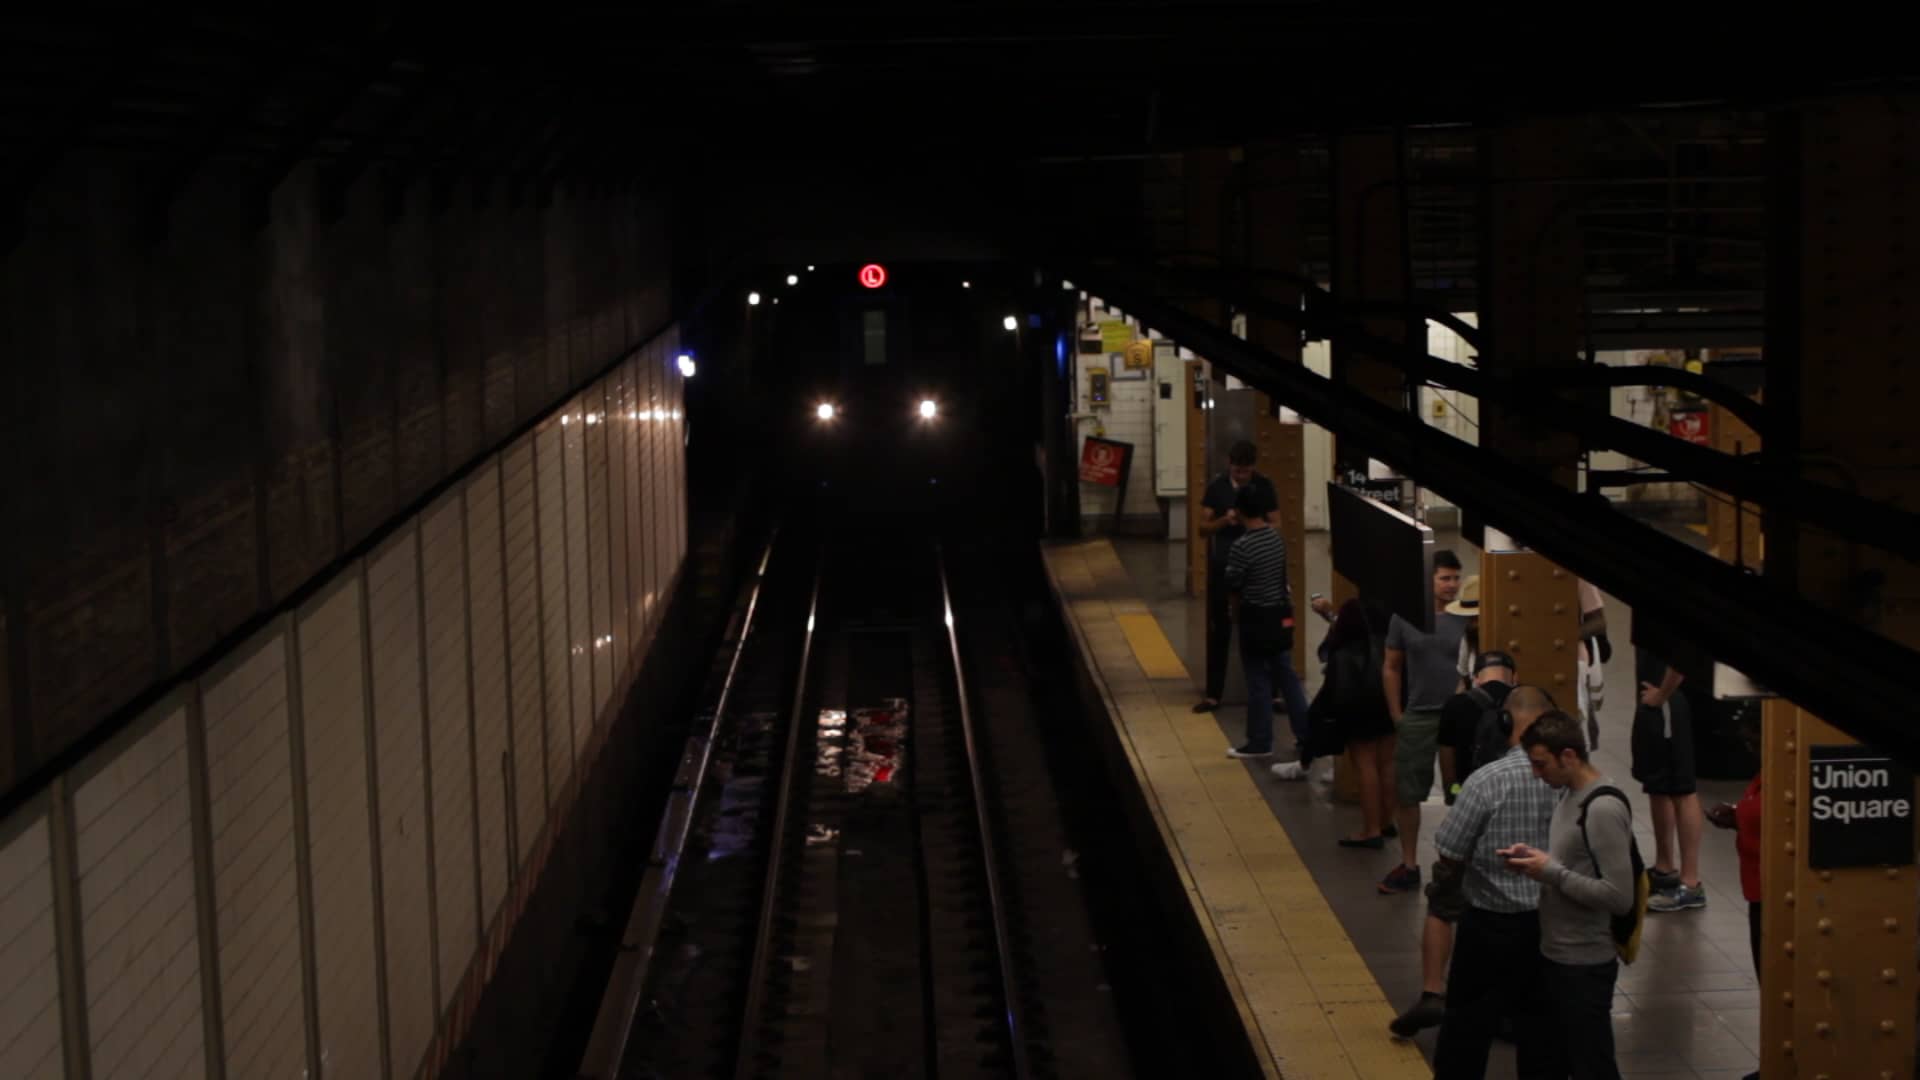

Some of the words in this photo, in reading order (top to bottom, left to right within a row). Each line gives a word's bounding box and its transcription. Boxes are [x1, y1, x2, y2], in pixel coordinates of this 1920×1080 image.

[1347, 469, 1366, 485] 14
[1350, 485, 1400, 502] treet
[1812, 763, 1889, 790] Union
[1811, 795, 1911, 824] Square
